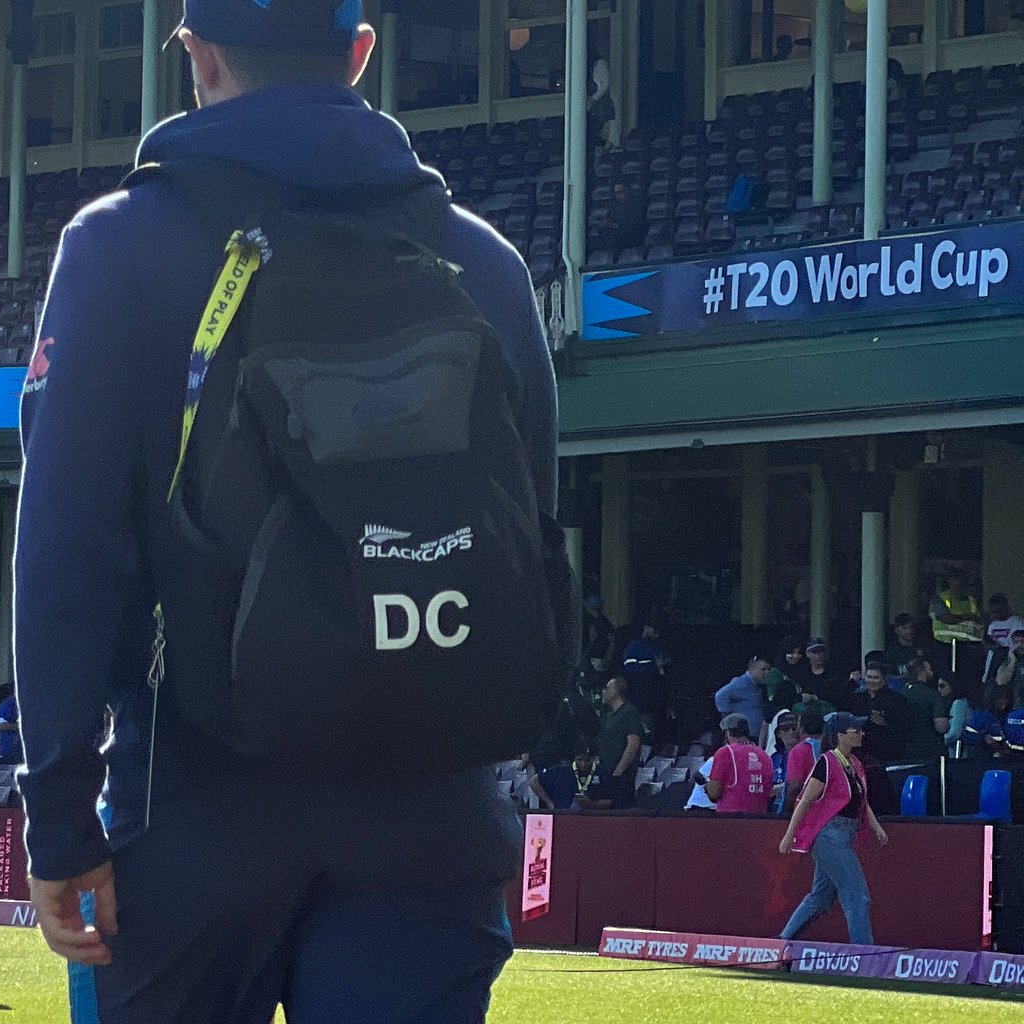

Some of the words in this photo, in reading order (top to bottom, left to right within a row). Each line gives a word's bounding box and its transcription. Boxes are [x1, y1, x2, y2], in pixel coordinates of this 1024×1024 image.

[703, 259, 799, 314] #T20
[804, 242, 924, 303] World
[930, 239, 1009, 297] Cup
[222, 280, 237, 301] OF
[205, 300, 228, 336] PLAY
[439, 526, 472, 544] ZEALAND
[363, 535, 473, 562] BLACKCAPS
[373, 589, 471, 651] DC
[5, 818, 13, 854] WATER
[603, 937, 646, 955] MRF
[647, 940, 689, 959] TYRES
[693, 943, 736, 961] MRF
[737, 946, 780, 963] TYRES
[815, 950, 861, 973] BYJU'S
[912, 958, 960, 979] BYJU'S
